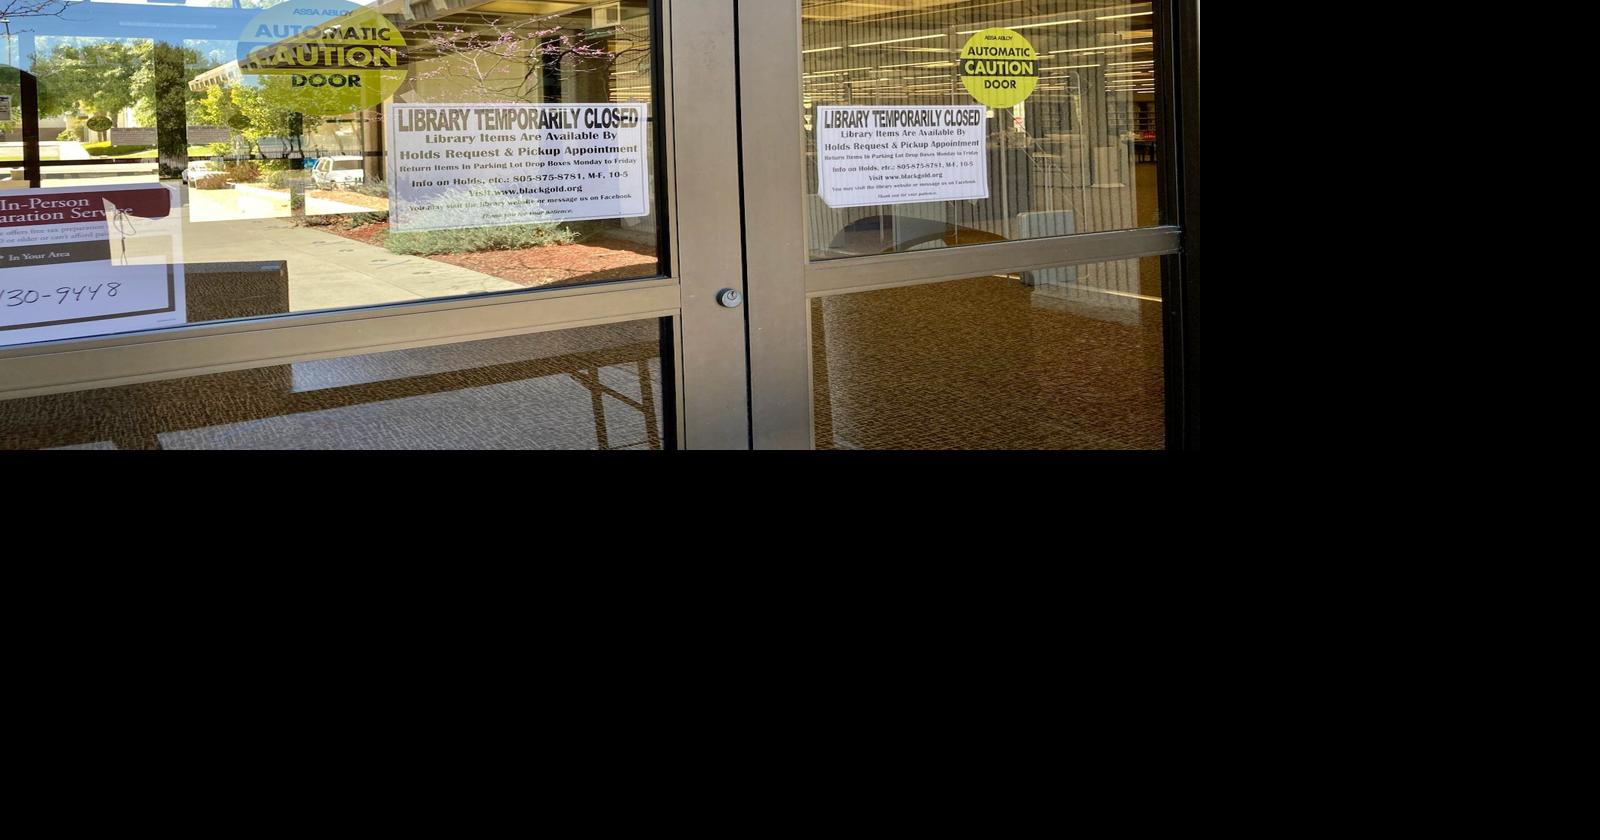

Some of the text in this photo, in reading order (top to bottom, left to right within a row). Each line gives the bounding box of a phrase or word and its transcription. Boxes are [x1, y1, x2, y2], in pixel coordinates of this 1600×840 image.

[255, 24, 391, 41] AUTOMATIC
[968, 47, 1030, 57] AUTOMATIC
[964, 60, 1034, 75] CAUTION
[291, 74, 362, 88] DOOR
[984, 80, 1016, 89] DOOR
[398, 108, 639, 132] LIBRARY TEMPORARILY CLOSED
[824, 109, 980, 129] LIBRARY TEMPORARILY CLOSED
[425, 131, 618, 144] Library Items Are Available By
[918, 128, 954, 136] Available
[853, 142, 889, 151] Request
[900, 141, 929, 149] Pickup
[931, 140, 979, 149] Appointment
[400, 145, 638, 160] Holds Request & Pickup Appointment
[513, 173, 585, 183] 805-875-8781,
[494, 185, 583, 196] www.blackgold.org
[2, 198, 90, 211] In-Person
[0, 282, 122, 306] 30-9448
